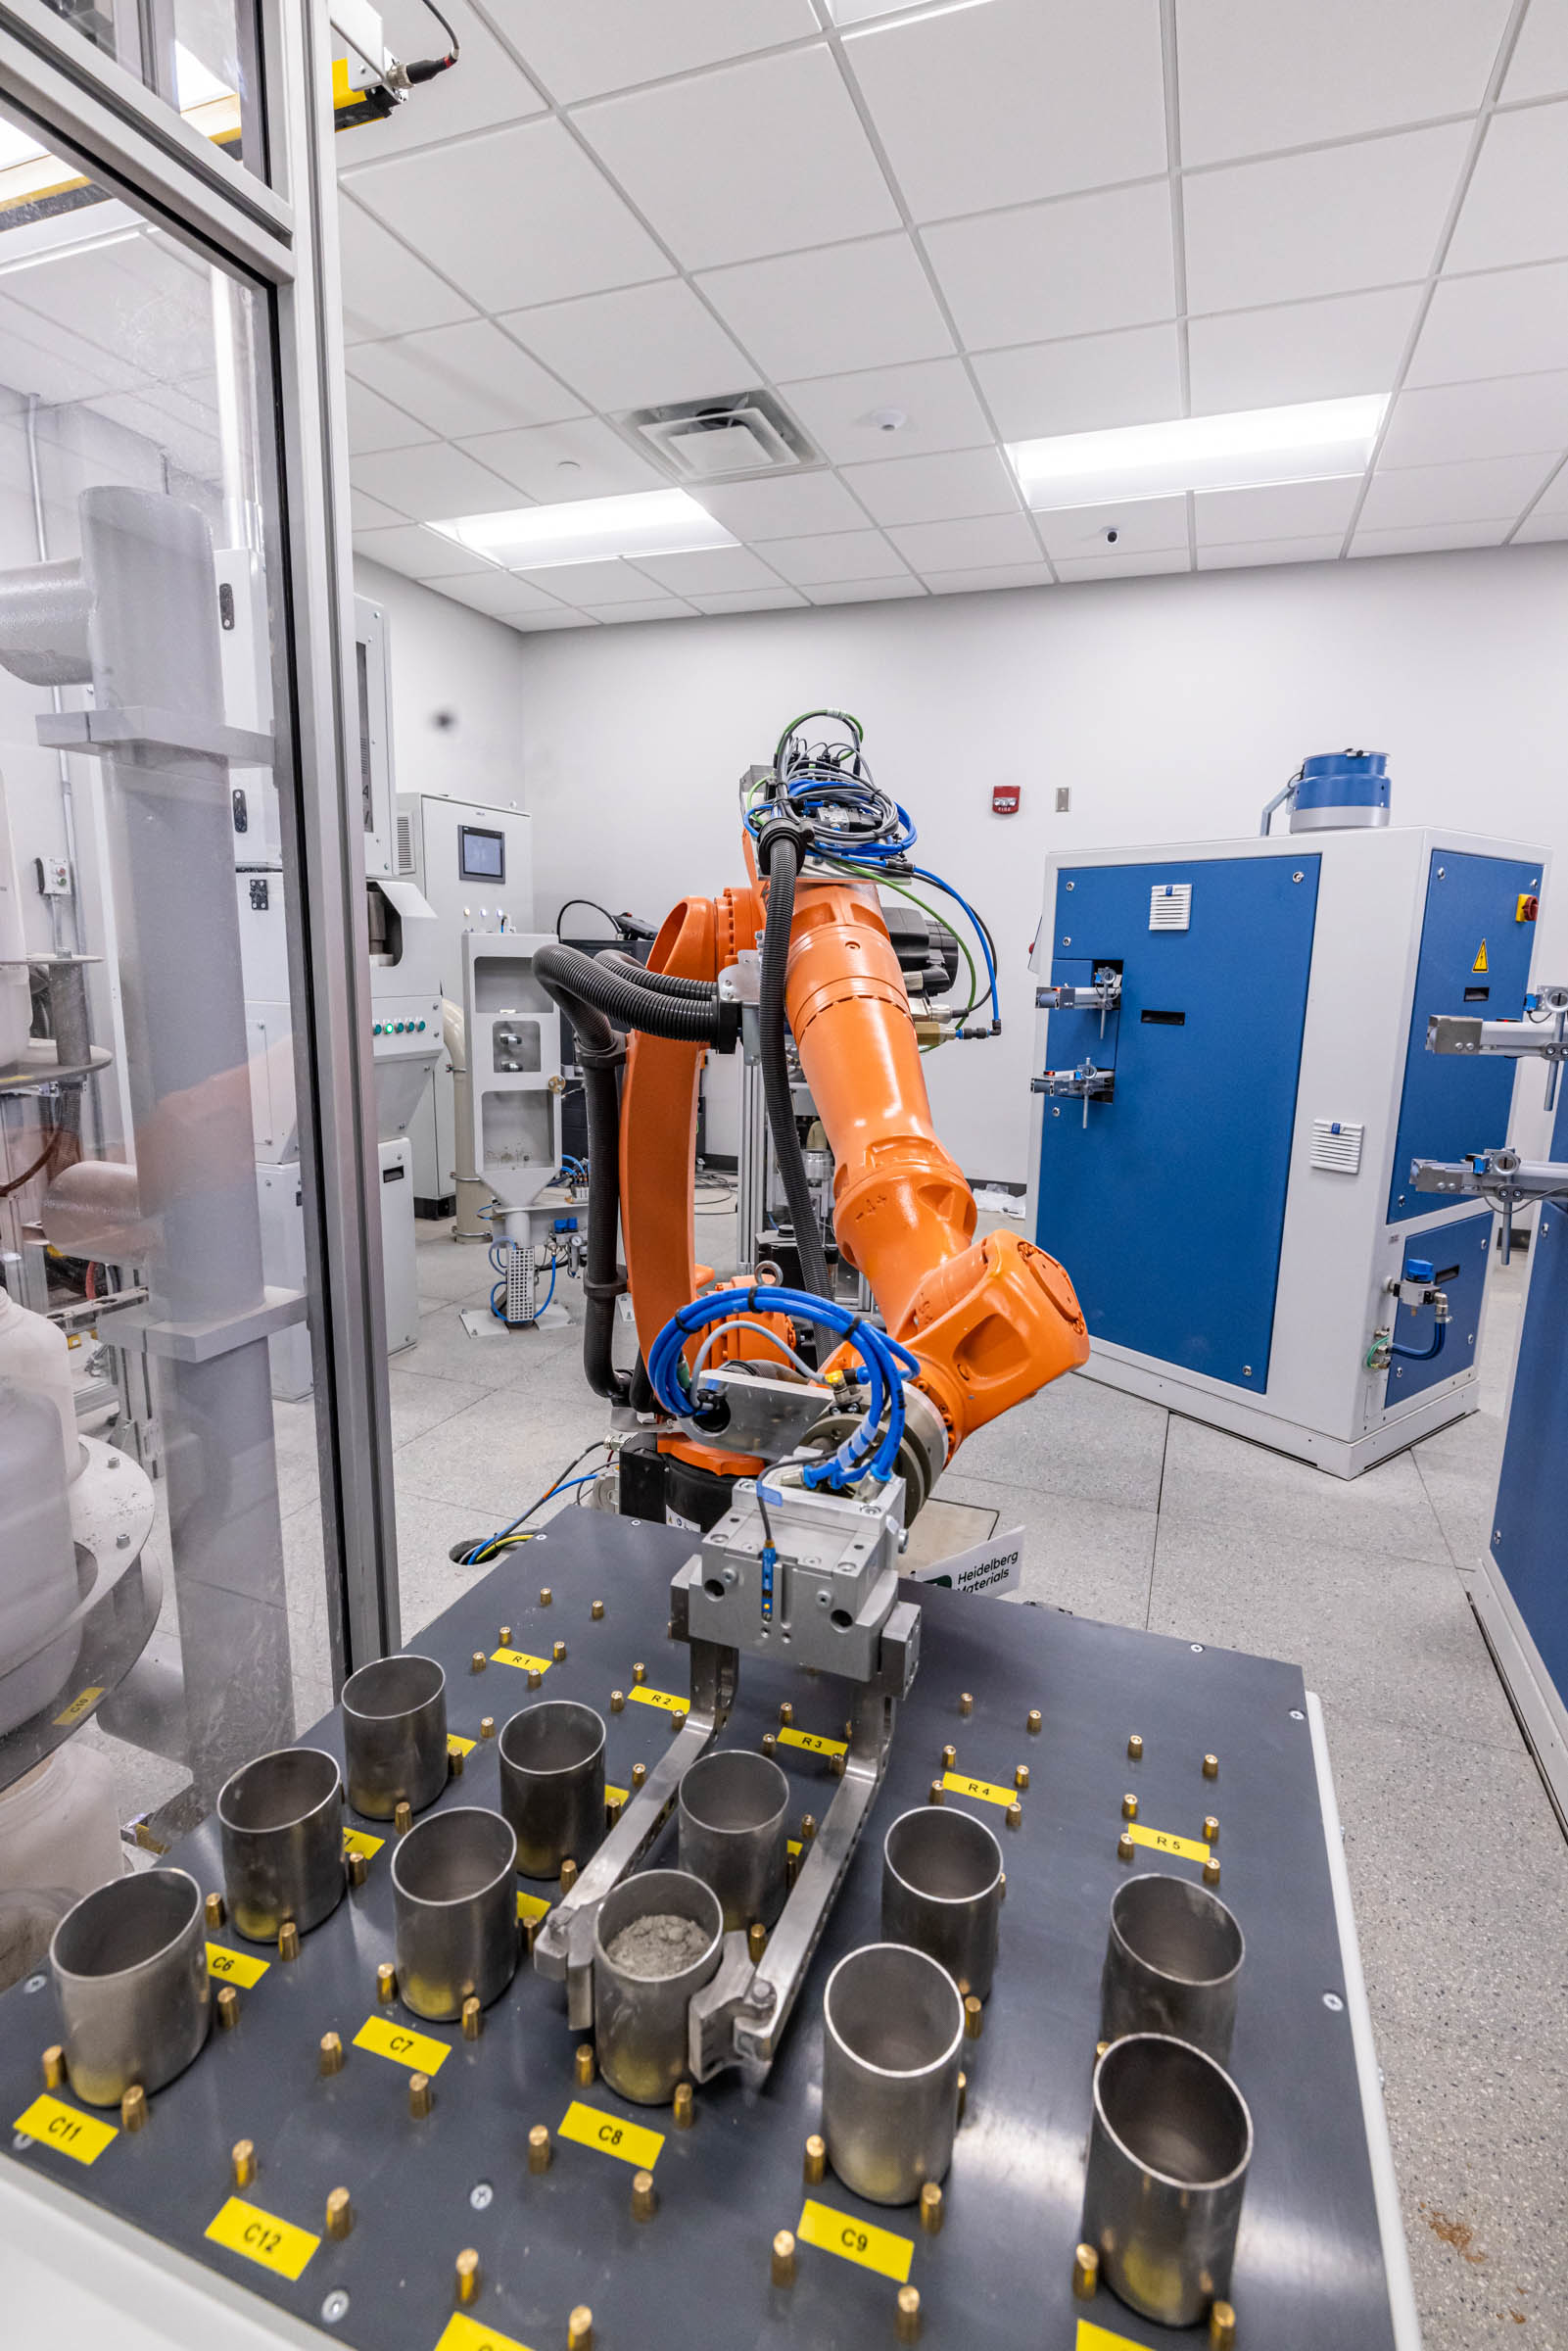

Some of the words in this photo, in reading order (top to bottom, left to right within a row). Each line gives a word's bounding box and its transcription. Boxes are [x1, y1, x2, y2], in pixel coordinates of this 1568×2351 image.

[957, 1551, 1019, 1585] Heidelberg
[212, 1956, 235, 1972] C6
[389, 2037, 414, 2053] C7
[48, 2117, 82, 2141] C11
[597, 2125, 624, 2145] C8
[244, 2224, 282, 2253] C12
[840, 2229, 869, 2252] C9
